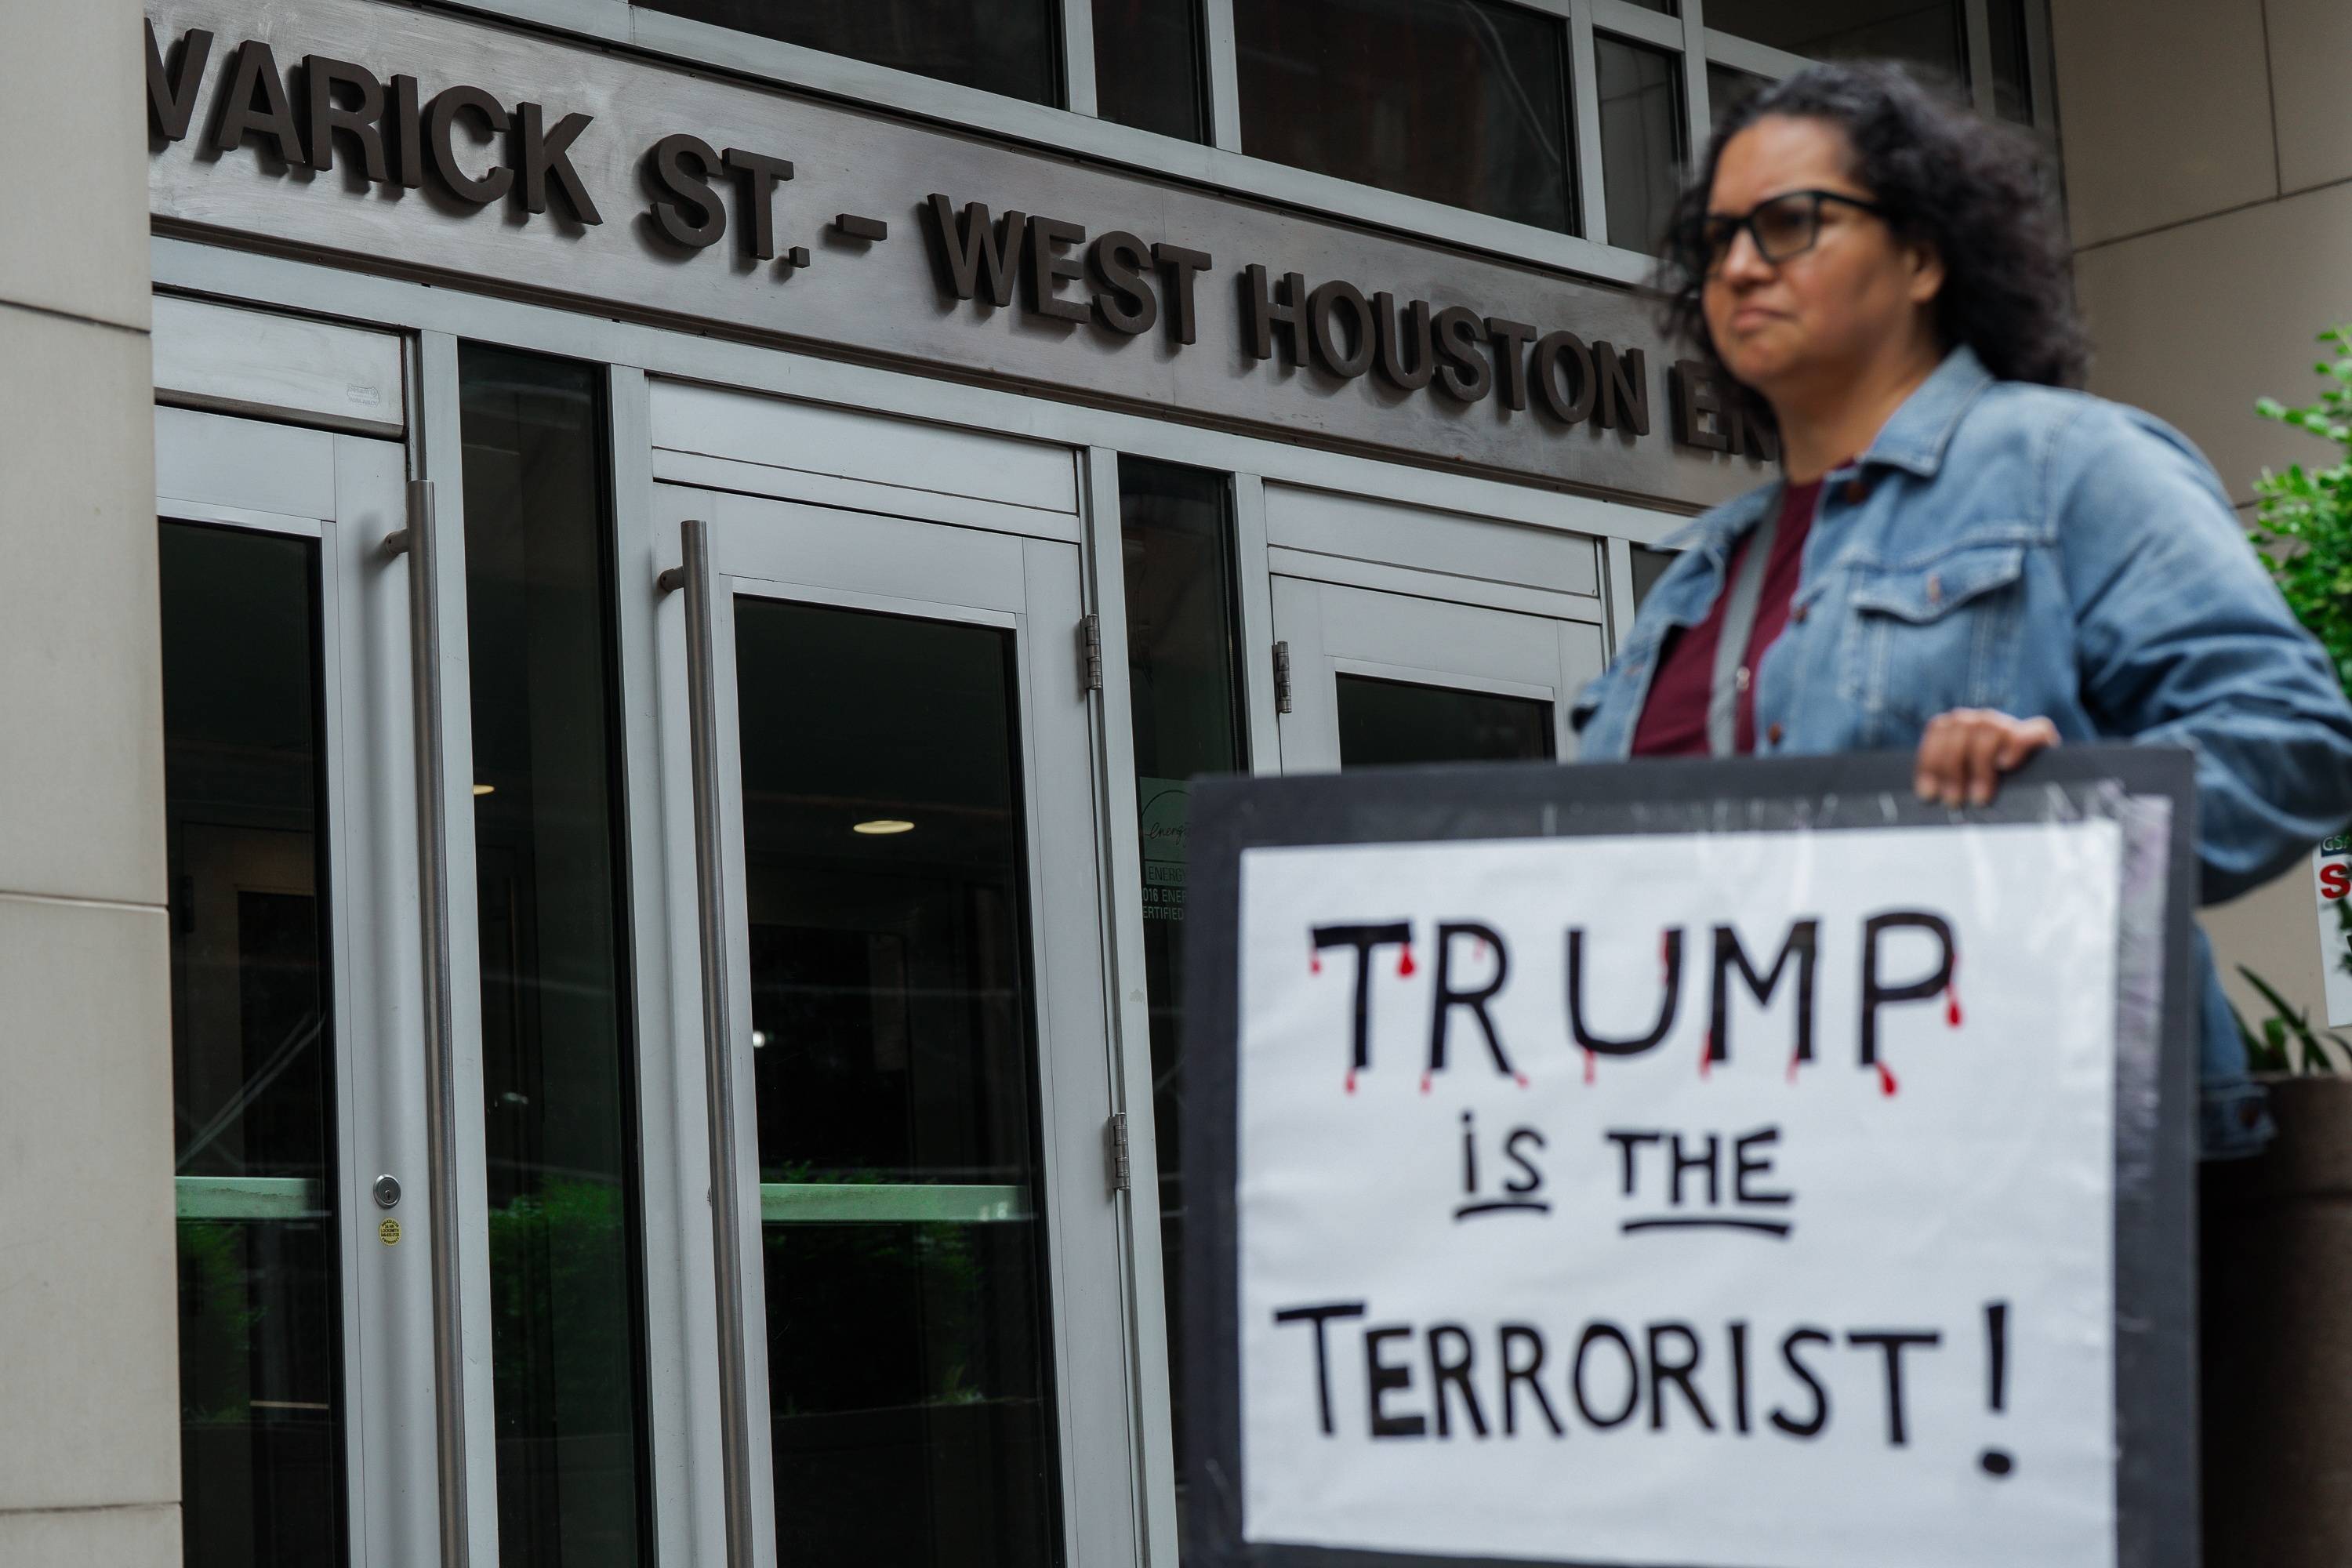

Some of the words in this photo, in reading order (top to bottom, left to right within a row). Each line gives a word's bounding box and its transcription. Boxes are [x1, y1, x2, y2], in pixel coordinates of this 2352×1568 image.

[144, 16, 604, 227] VARICK
[927, 193, 1212, 346] WEST
[1245, 263, 1650, 436] HOUSTON
[1142, 887, 1160, 902] 016
[1309, 908, 1956, 1079] TRUMP
[1605, 1124, 1796, 1206] THE
